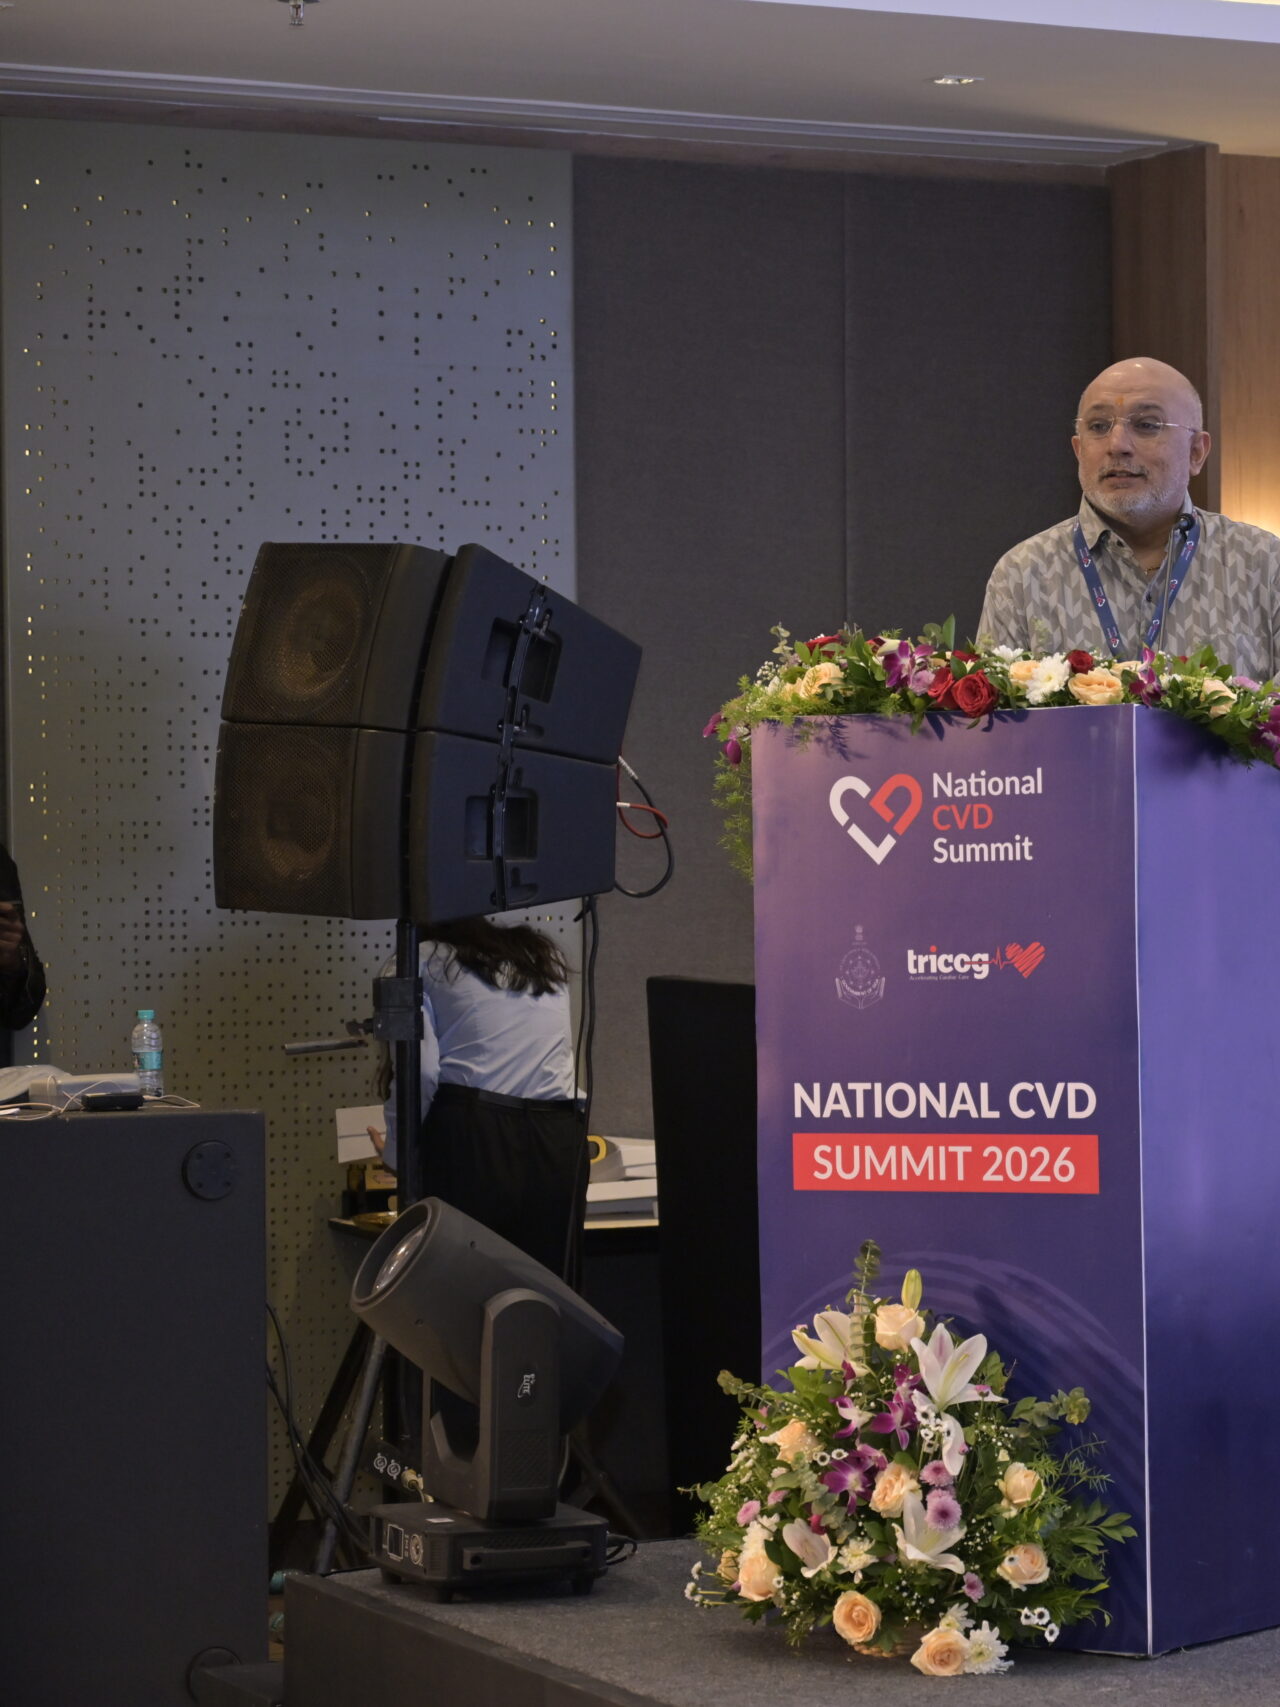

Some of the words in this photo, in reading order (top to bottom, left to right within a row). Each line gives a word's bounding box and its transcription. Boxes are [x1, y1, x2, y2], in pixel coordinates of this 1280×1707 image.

[932, 767, 1043, 799] National
[932, 804, 994, 831] CVD
[933, 834, 1033, 864] Summit
[907, 945, 990, 980] tricog
[793, 1081, 1000, 1119] NATIONAL
[1008, 1081, 1097, 1119] CVD
[813, 1144, 972, 1181] SUMMIT
[982, 1145, 1076, 1183] 2026
